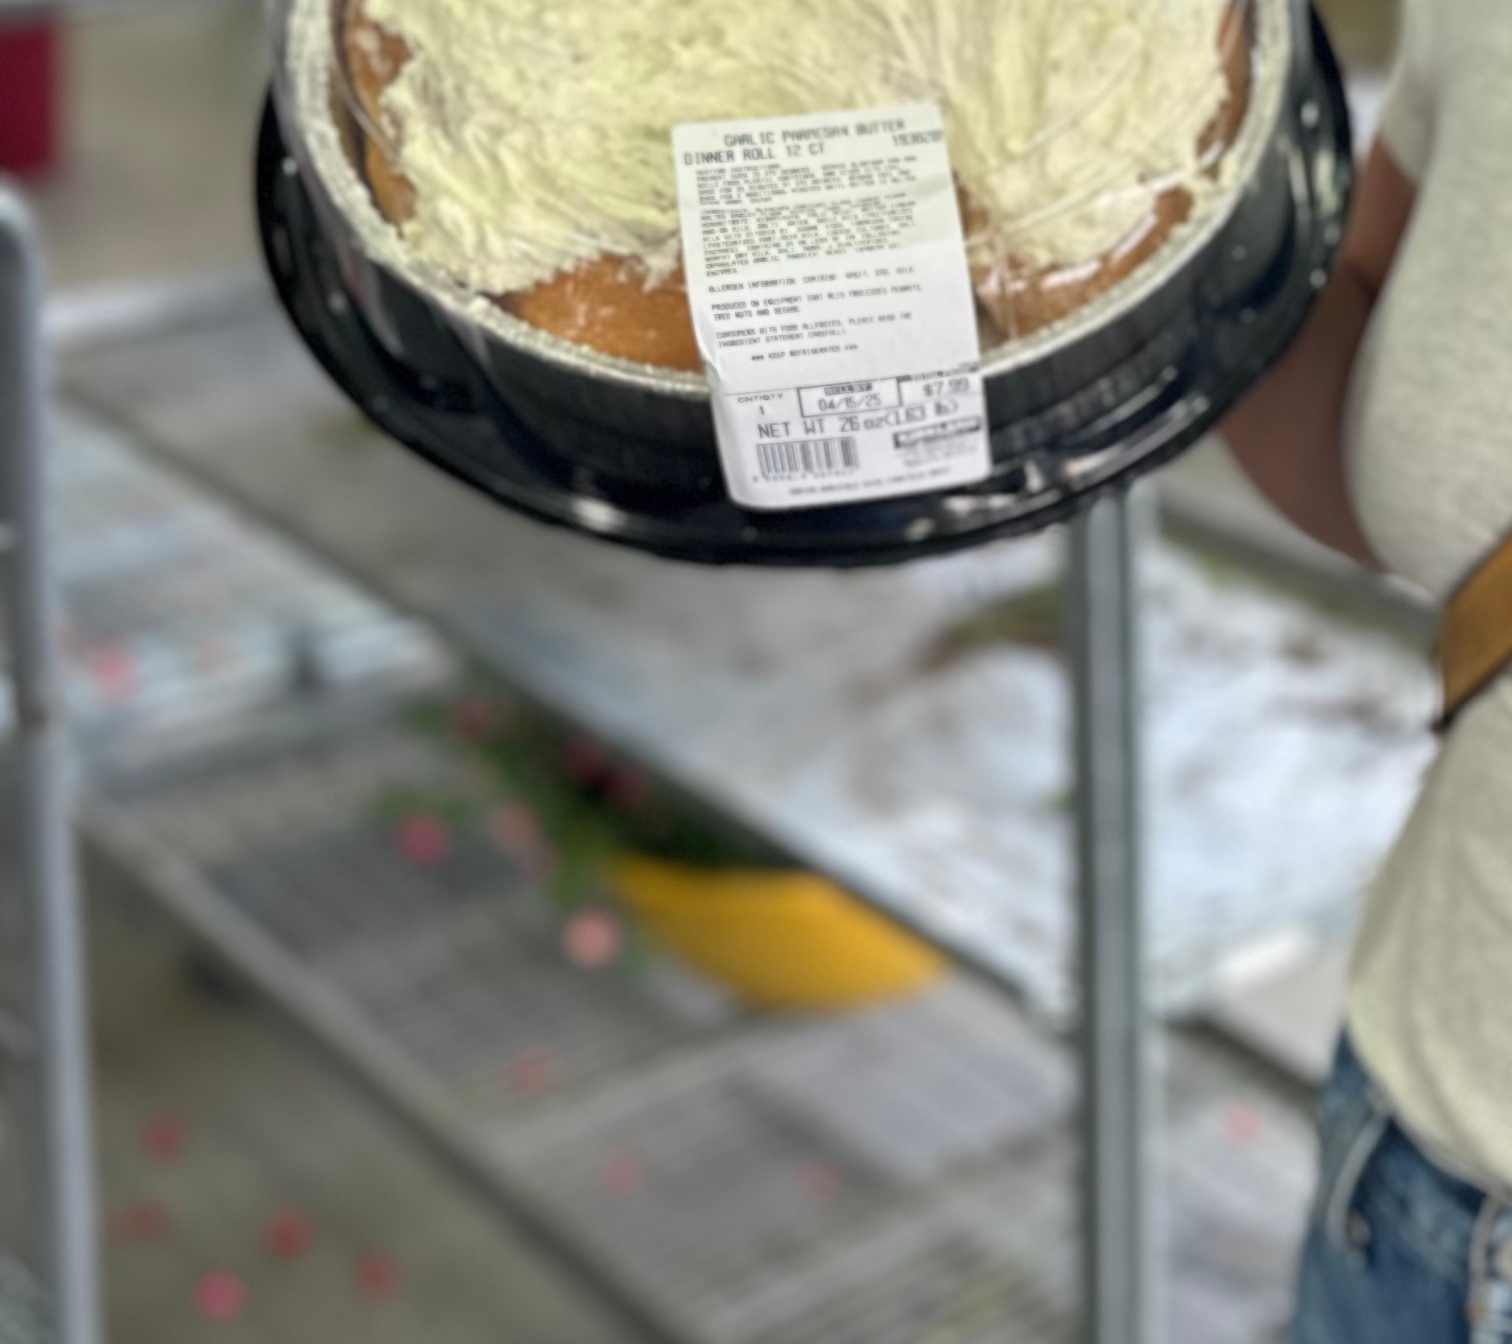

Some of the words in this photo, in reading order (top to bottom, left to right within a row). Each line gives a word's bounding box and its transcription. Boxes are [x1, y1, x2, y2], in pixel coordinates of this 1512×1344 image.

[724, 132, 774, 147] GARLIC
[781, 125, 849, 141] PARMESAN
[855, 119, 905, 134] BUTTER
[683, 150, 734, 165] DINNER
[742, 146, 776, 160] ROLL
[785, 144, 801, 156] 12
[808, 141, 825, 153] CT
[818, 394, 881, 411] 04/15/25
[758, 422, 791, 439] NET
[803, 419, 825, 434] WT
[838, 416, 860, 433] 26
